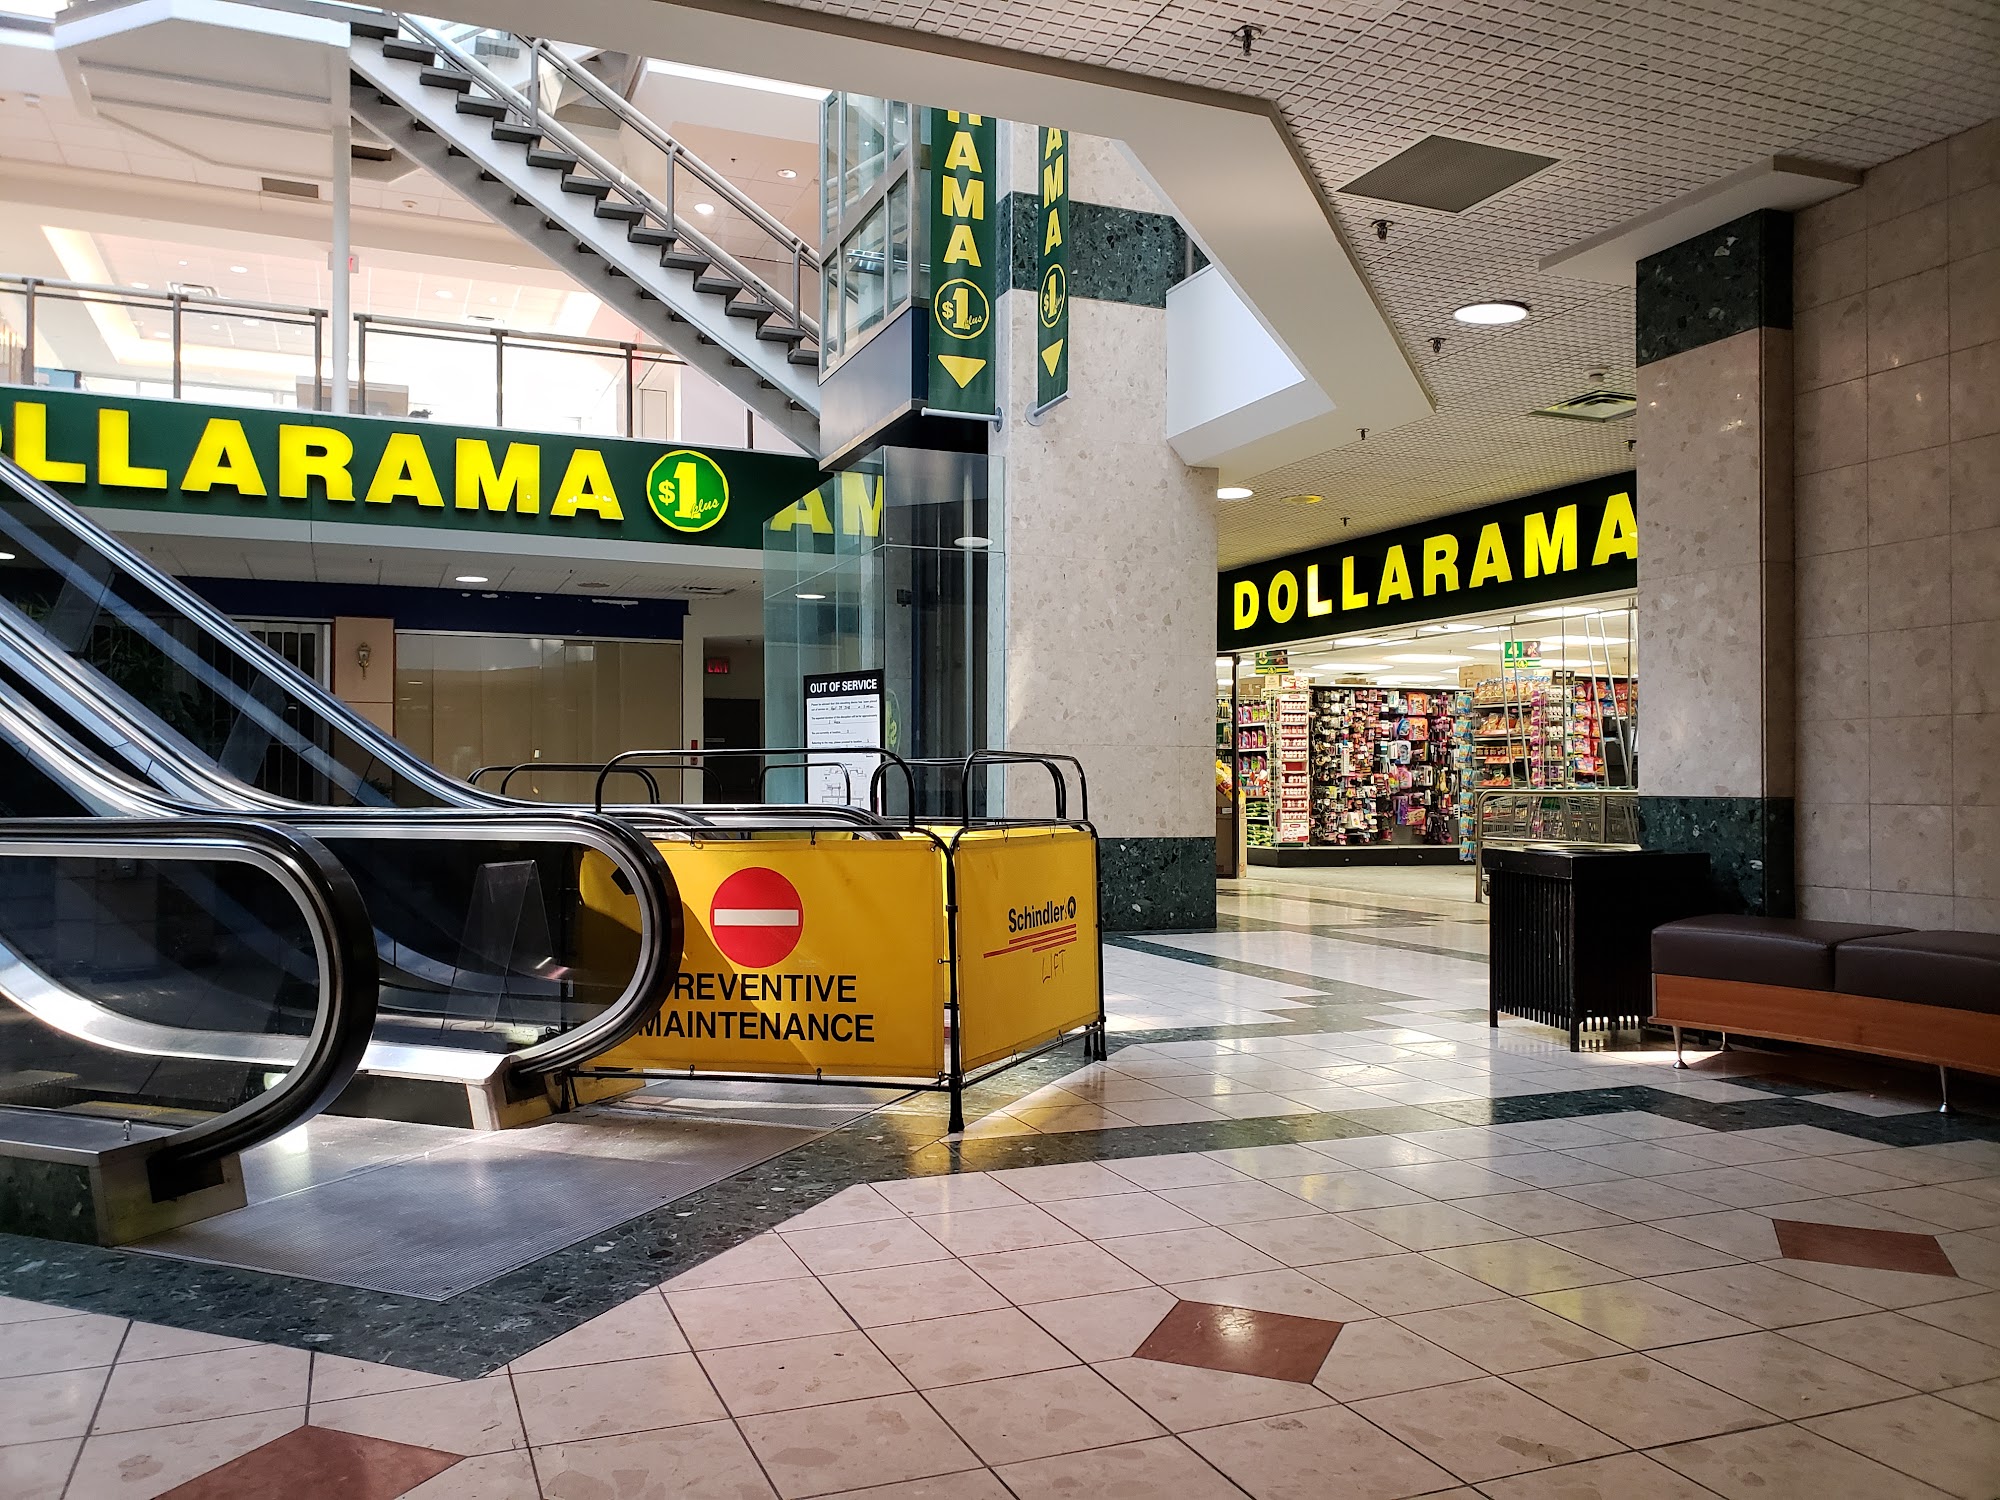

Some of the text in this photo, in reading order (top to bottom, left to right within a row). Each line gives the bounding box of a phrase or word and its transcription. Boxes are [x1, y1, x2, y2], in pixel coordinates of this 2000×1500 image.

[942, 110, 984, 267] AMA
[0, 402, 625, 521] LLARAMA
[691, 499, 719, 519] plus
[1234, 492, 1637, 630] DOLLARAMA
[1508, 642, 1519, 657] 4
[810, 679, 877, 693] OUT OF SERVICE
[1042, 949, 1066, 984] LIFT
[674, 973, 857, 1003] REVENTIVE
[638, 1010, 875, 1043] MAINTENANCE
